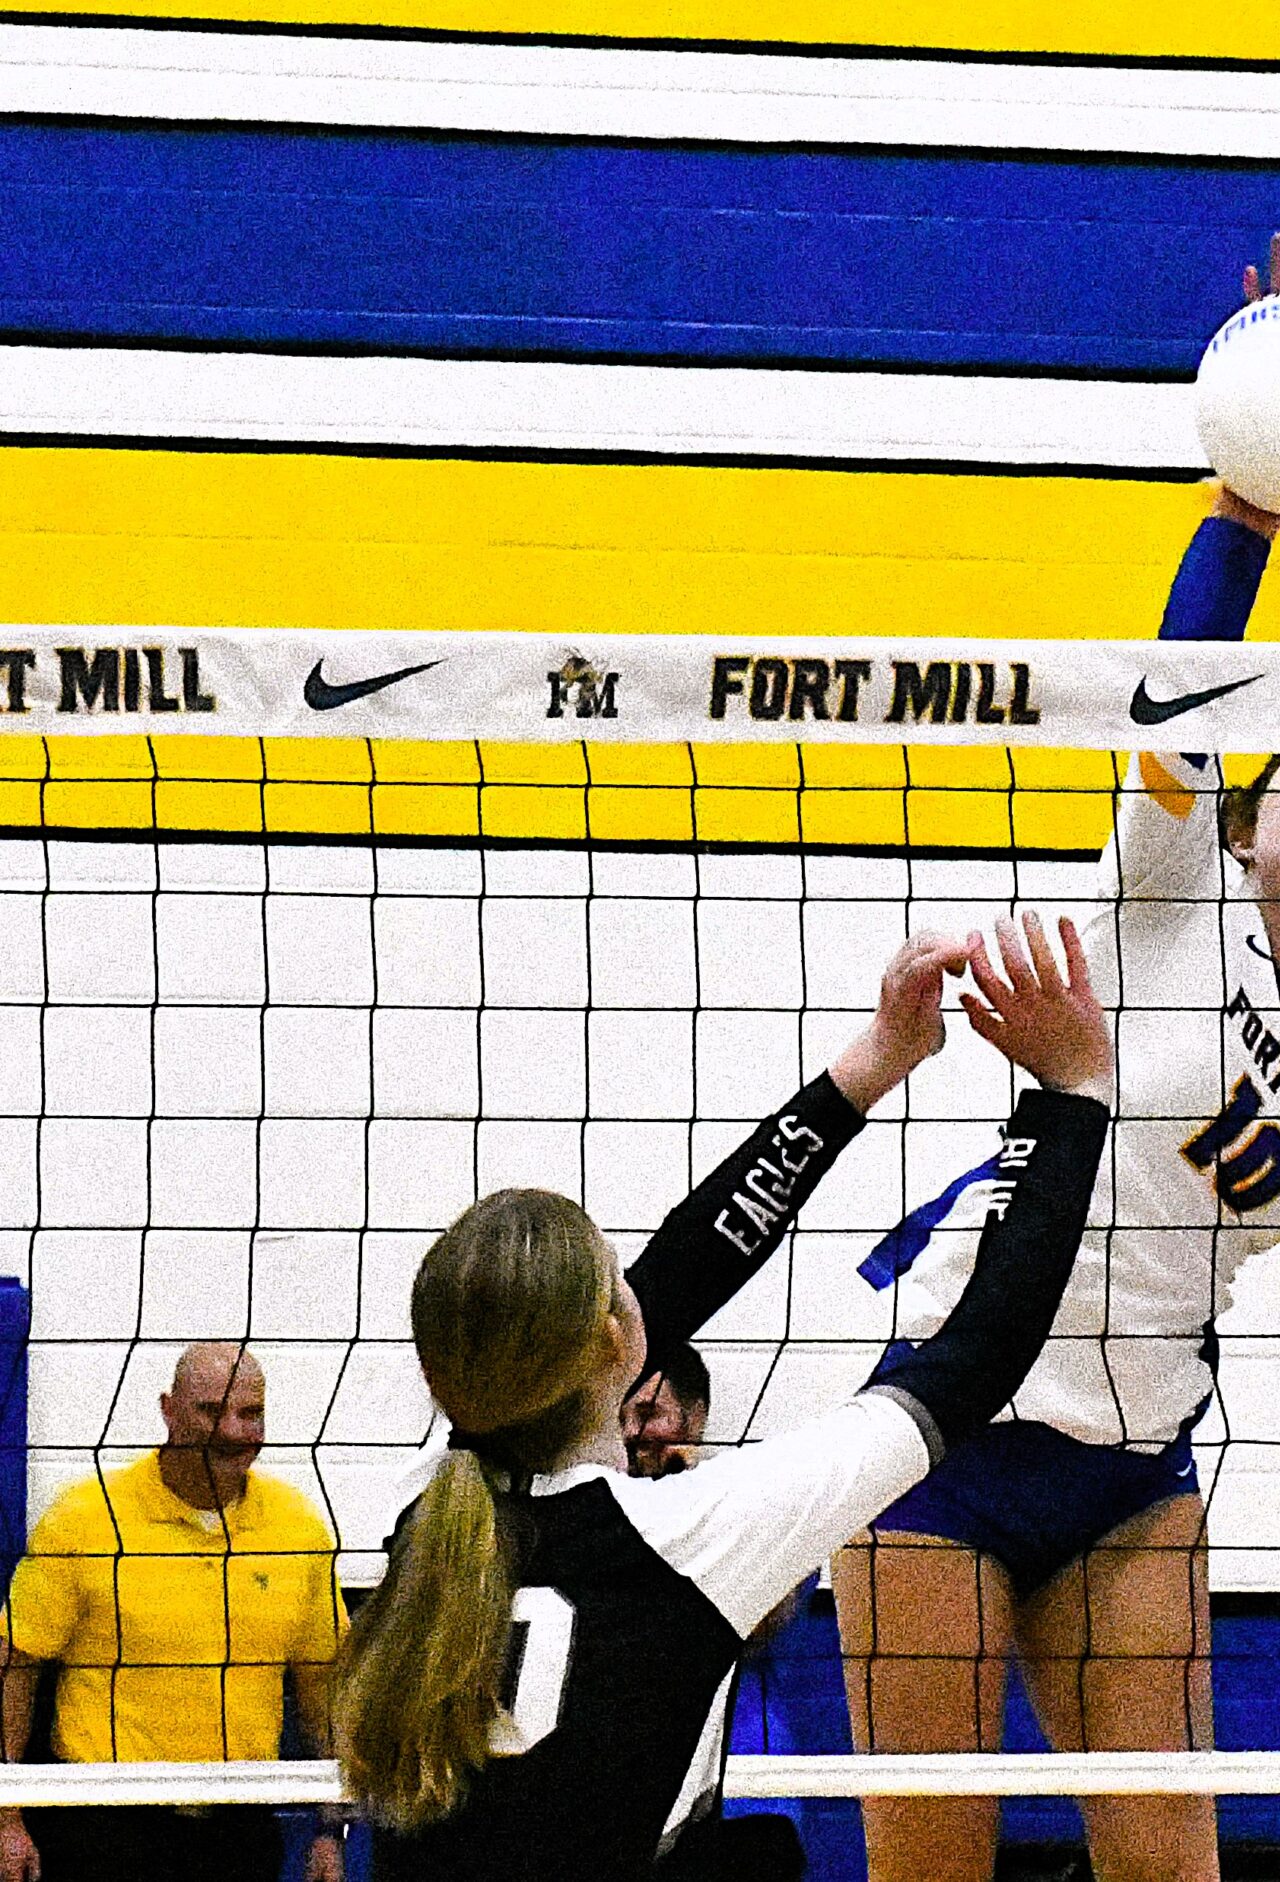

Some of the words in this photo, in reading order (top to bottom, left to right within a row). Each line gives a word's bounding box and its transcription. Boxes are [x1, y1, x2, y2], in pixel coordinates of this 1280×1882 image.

[55, 646, 217, 713] MILL
[709, 656, 871, 722] FORT
[885, 659, 1041, 726] MILL
[713, 1114, 824, 1256] EAGLES
